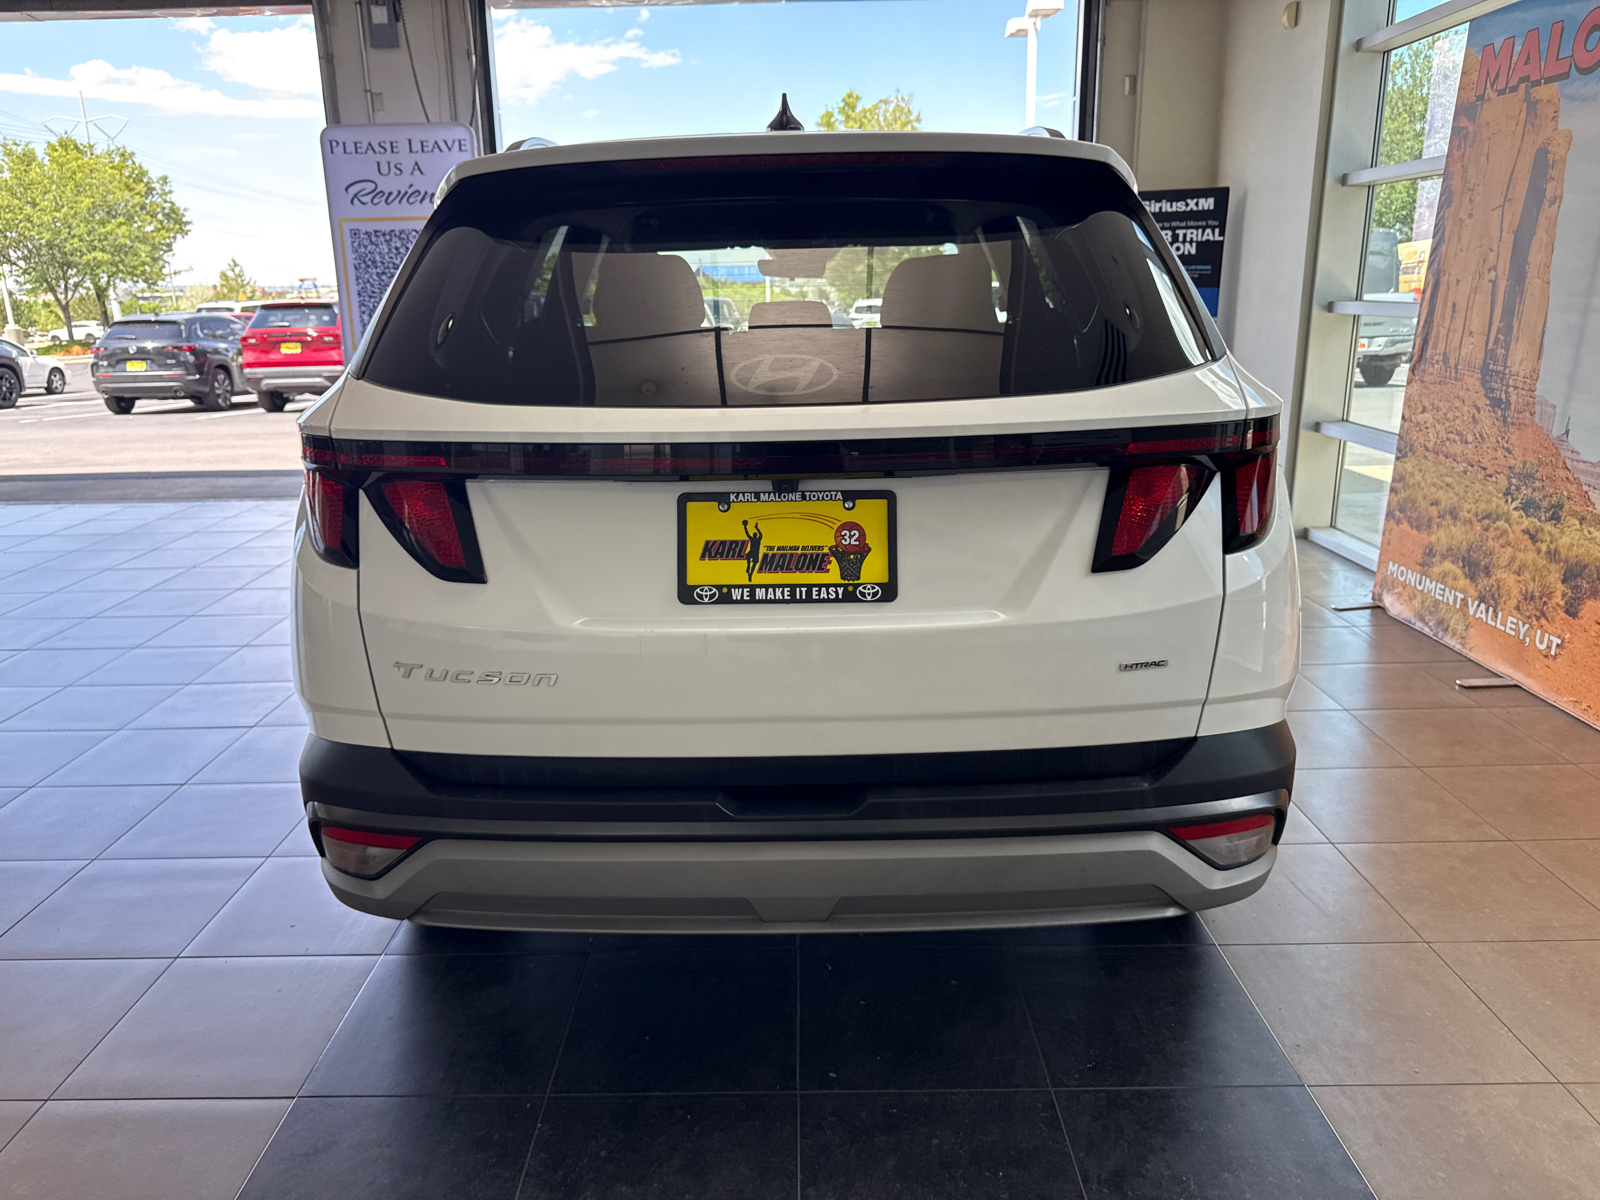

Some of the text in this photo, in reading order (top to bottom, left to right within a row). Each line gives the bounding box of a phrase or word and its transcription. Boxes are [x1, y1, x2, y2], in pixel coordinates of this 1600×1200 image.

[328, 138, 468, 155] PLEASE LEAVE
[410, 160, 425, 176] A
[1176, 228, 1224, 242] TRIAL
[730, 491, 843, 502] KARL MALONE TOYOTA
[841, 530, 860, 546] 32
[699, 539, 749, 561] KARL
[757, 552, 832, 574] MALONE
[731, 587, 844, 600] WE MAKE IT EASY
[1387, 561, 1561, 656] MONUMENT VALLEY, UT
[1124, 660, 1165, 670] HTRAC
